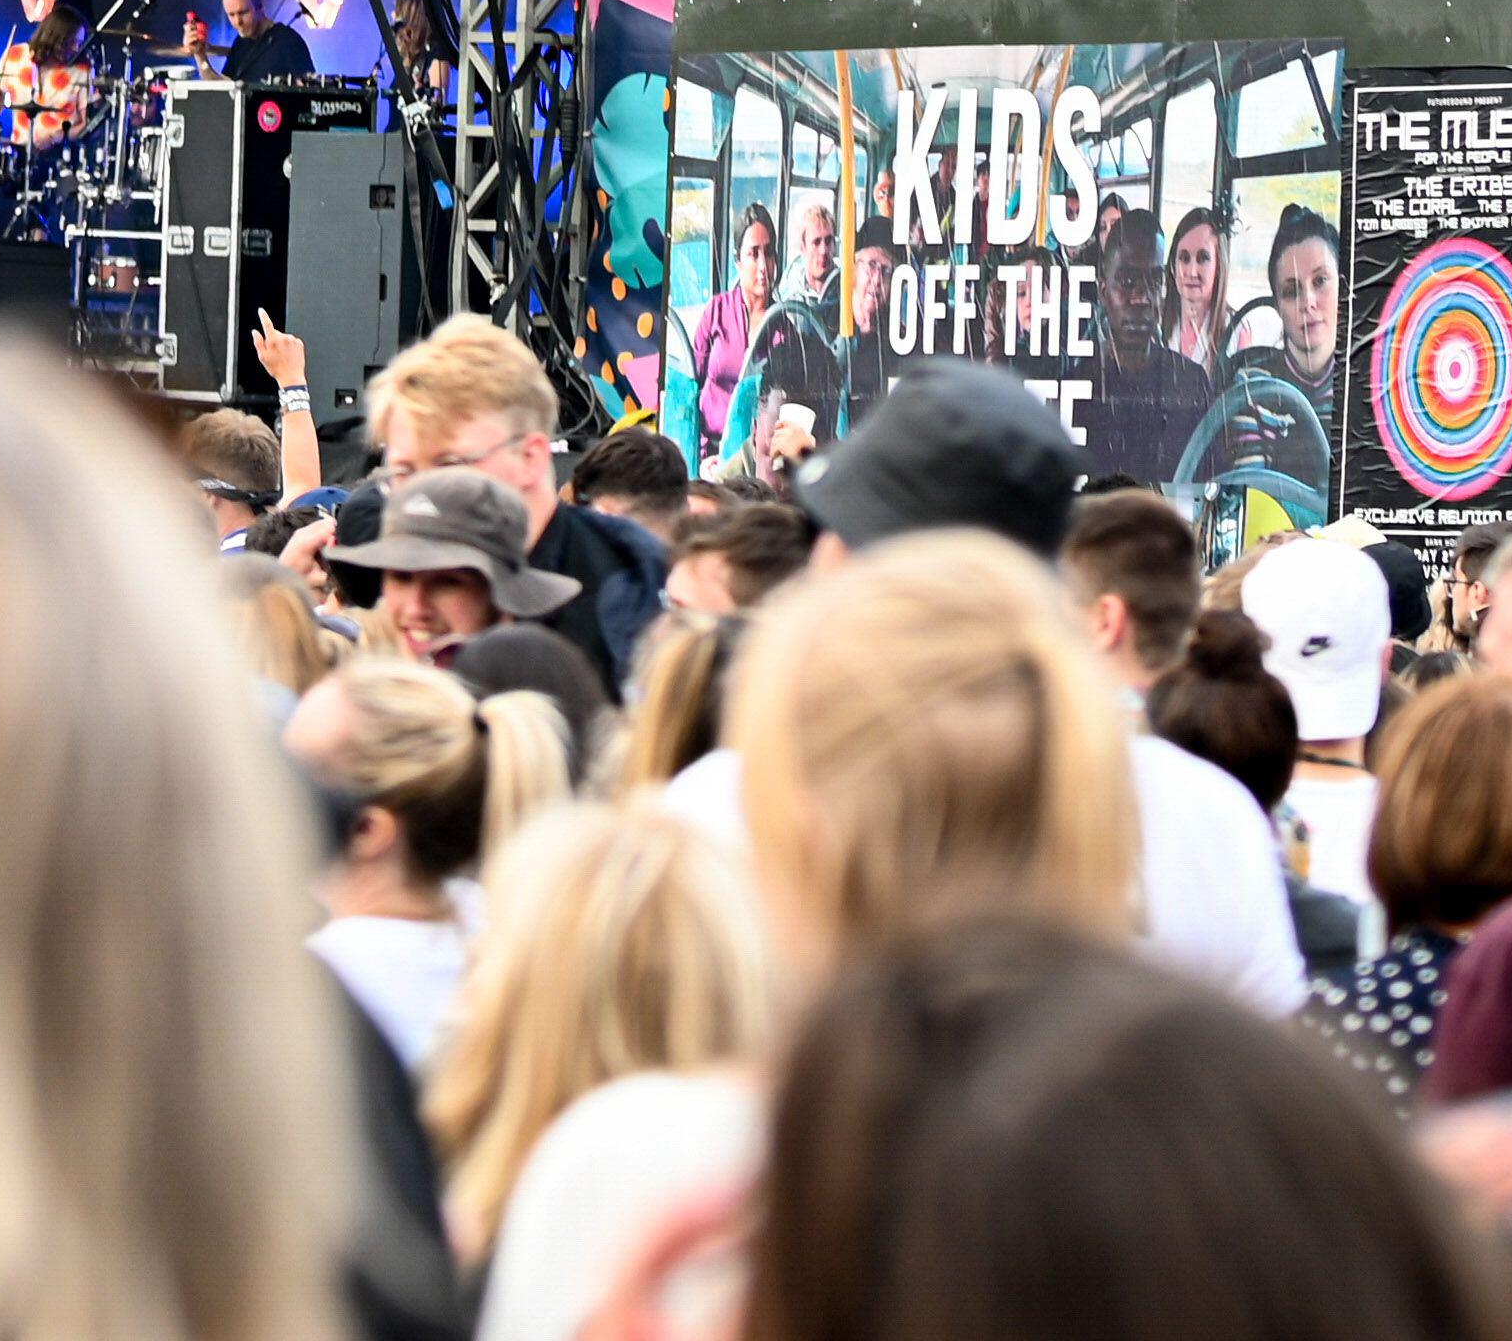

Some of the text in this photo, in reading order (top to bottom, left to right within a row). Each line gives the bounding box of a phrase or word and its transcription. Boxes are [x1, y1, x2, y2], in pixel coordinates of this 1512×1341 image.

[1358, 112, 1431, 151] THE
[892, 85, 1101, 246] KIDS
[1415, 150, 1511, 165] FOR THE PEOPLE
[1404, 176, 1443, 197] THE
[1373, 199, 1404, 216] THE
[1409, 198, 1462, 216] CORAL
[1477, 199, 1502, 213] THE
[1357, 219, 1380, 230] TIM
[1438, 217, 1458, 229] THE
[888, 265, 1096, 357] OFF THE
[1353, 508, 1434, 524] EXCLUSIVE
[1438, 509, 1502, 525] REUNION
